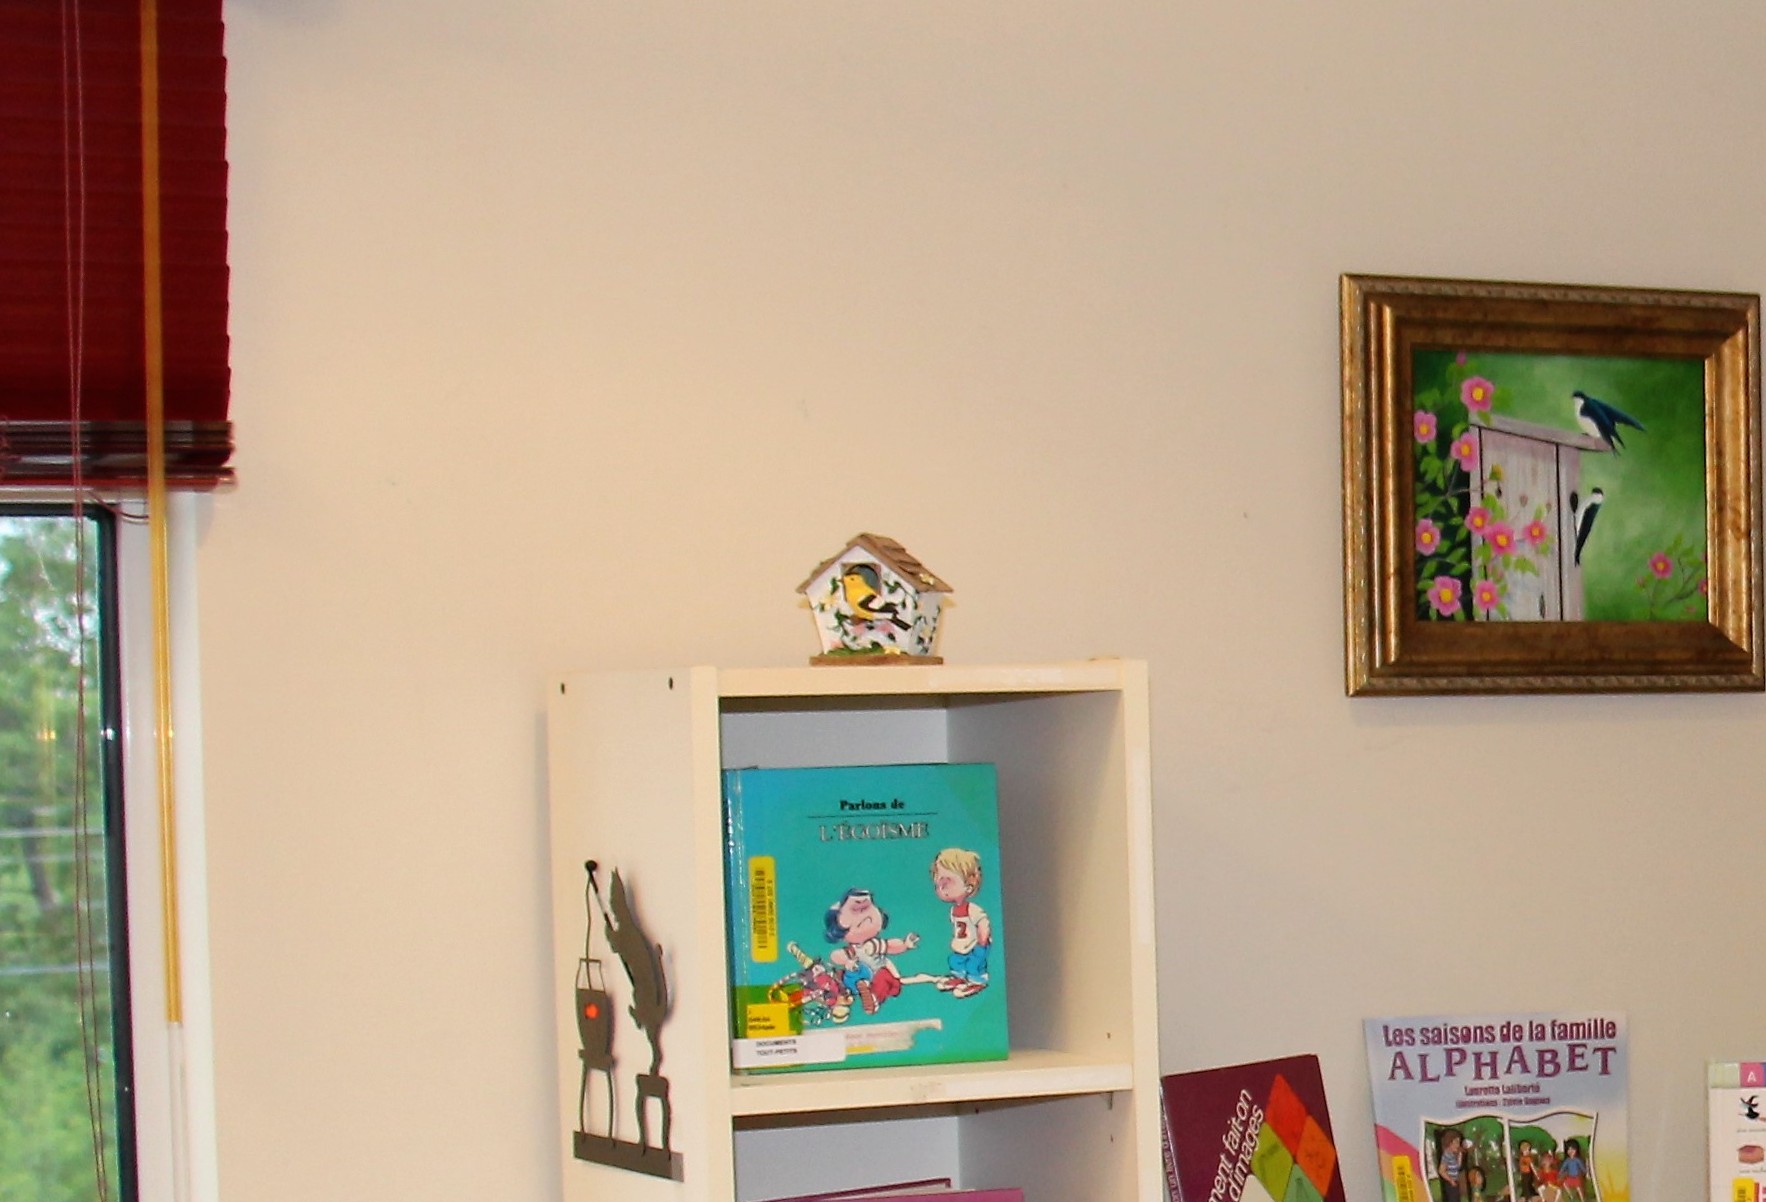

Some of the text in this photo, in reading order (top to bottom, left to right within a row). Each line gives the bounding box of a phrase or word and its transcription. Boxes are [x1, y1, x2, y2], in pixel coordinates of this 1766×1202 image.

[839, 799, 905, 811] Parlons de
[957, 921, 967, 939] 2
[1383, 1018, 1617, 1047] Les saisons de la famille
[1387, 1043, 1618, 1083] ALPHABET
[1747, 1071, 1757, 1083] A
[1228, 1104, 1265, 1201] d'images
